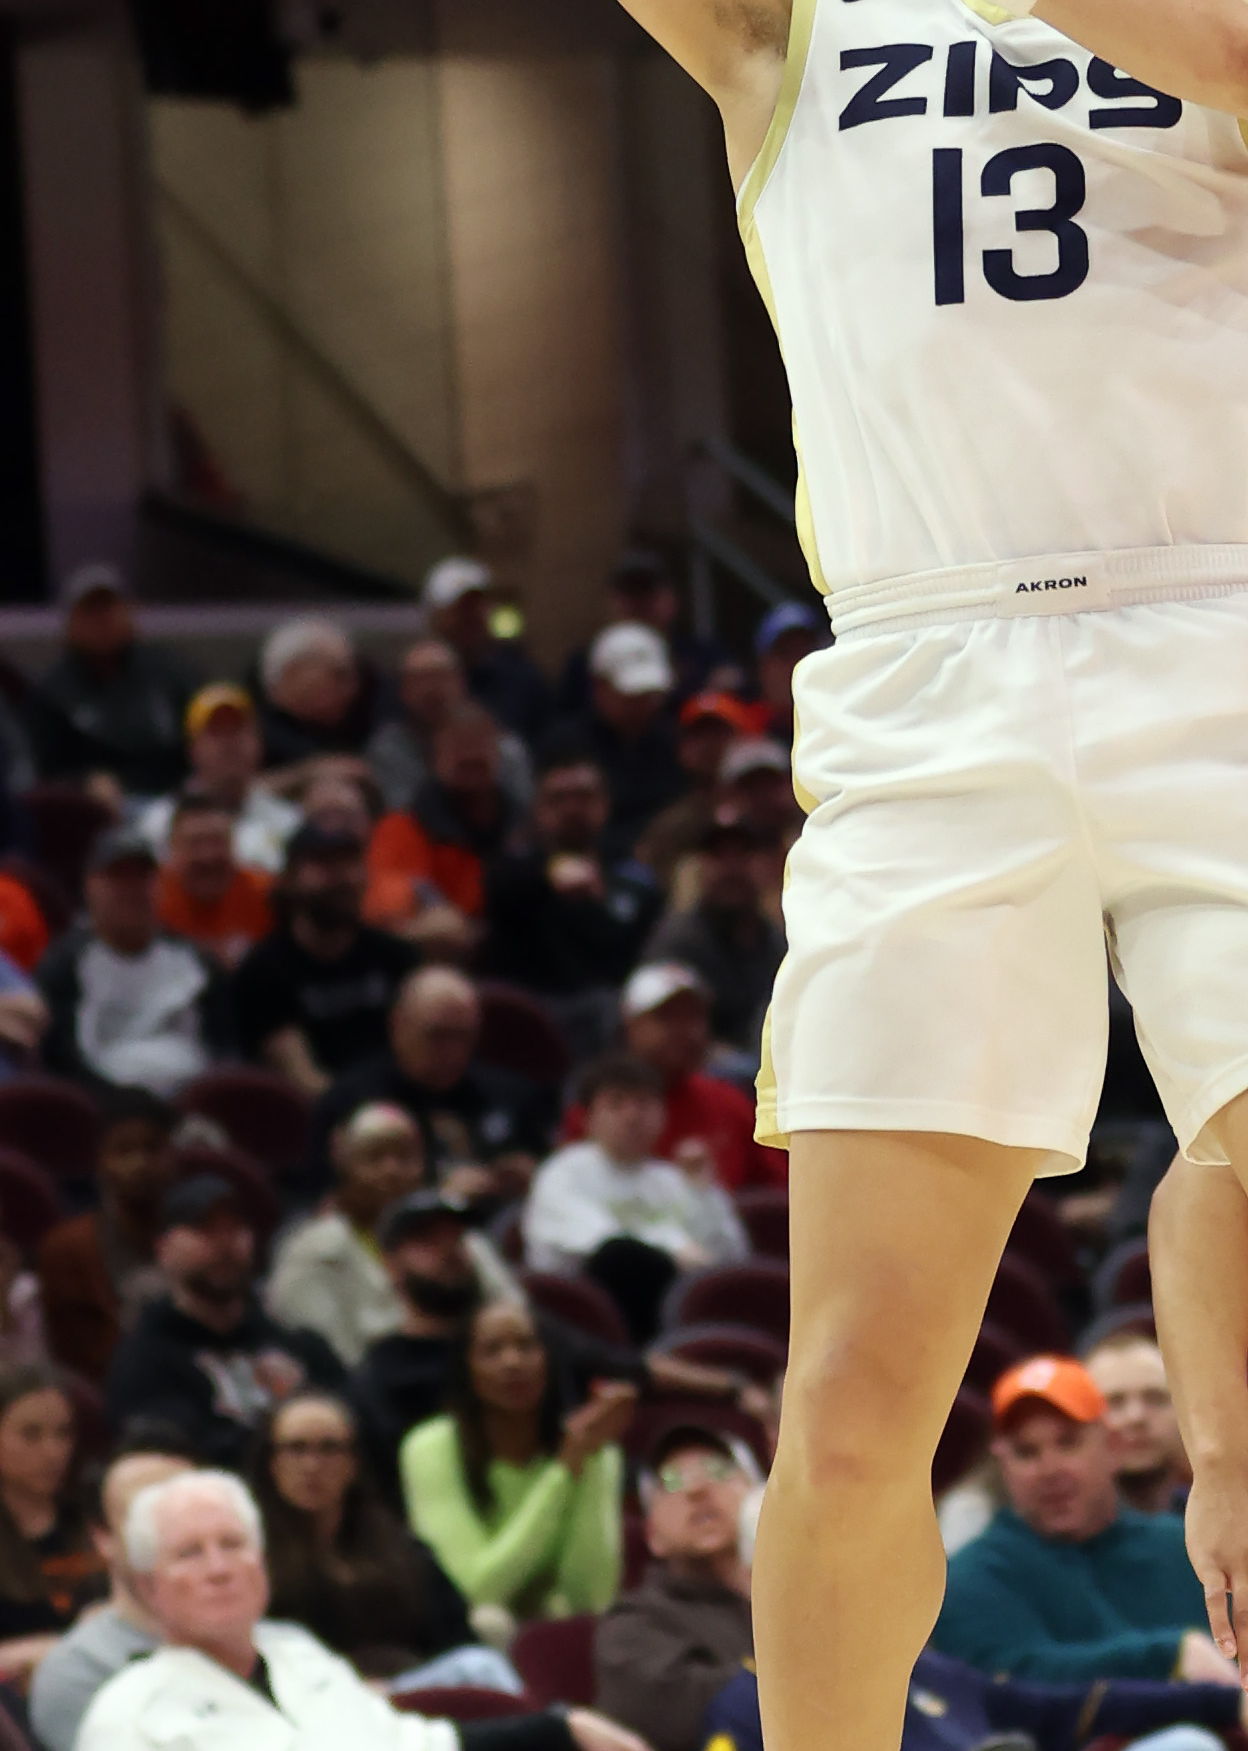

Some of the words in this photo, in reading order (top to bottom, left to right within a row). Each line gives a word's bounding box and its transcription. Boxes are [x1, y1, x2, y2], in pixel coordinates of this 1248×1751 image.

[838, 40, 1183, 132] ZIPS
[932, 143, 1090, 306] 13
[1015, 576, 1088, 594] AKRON
